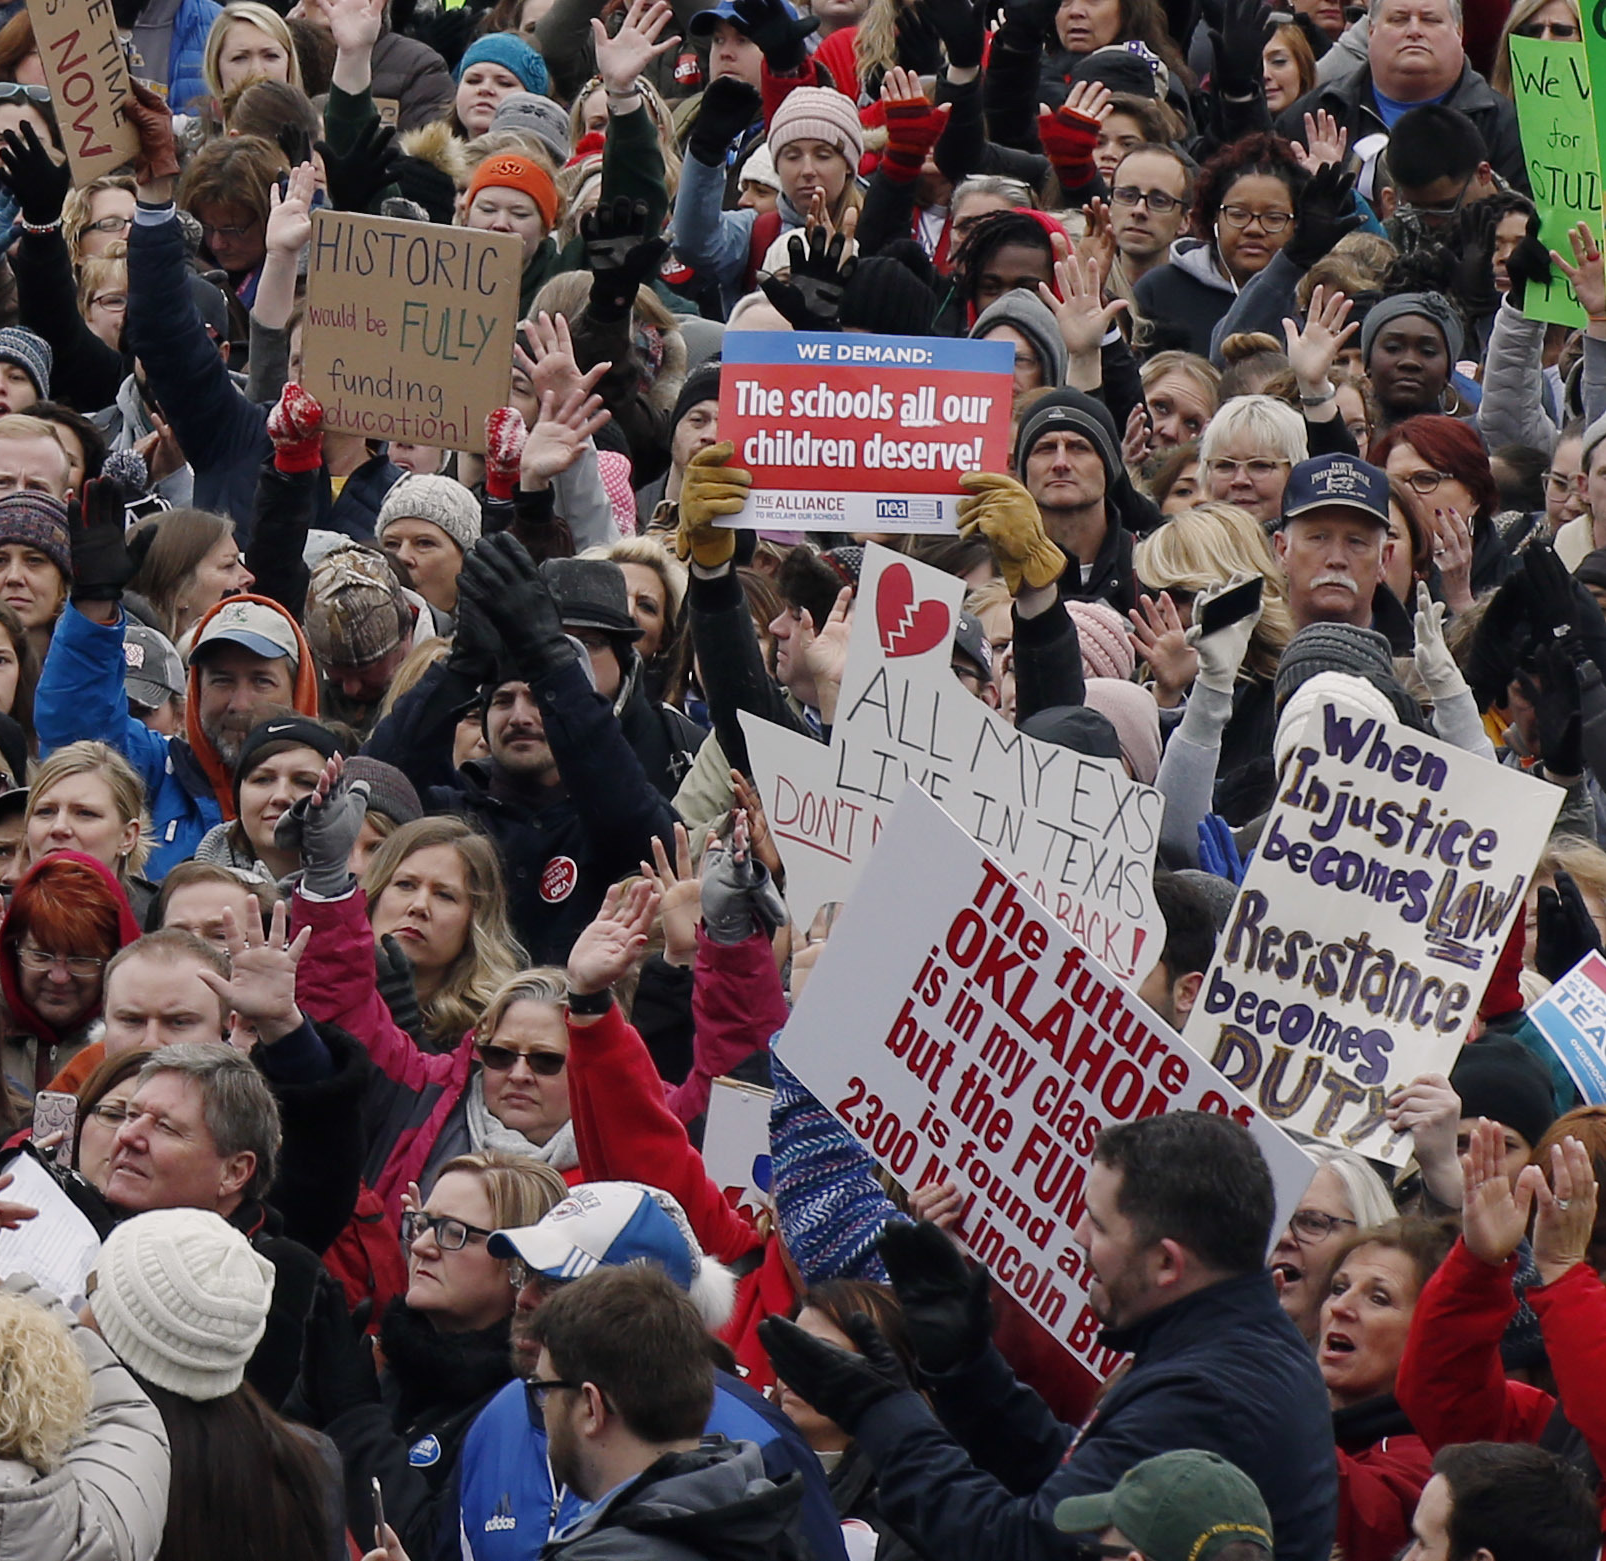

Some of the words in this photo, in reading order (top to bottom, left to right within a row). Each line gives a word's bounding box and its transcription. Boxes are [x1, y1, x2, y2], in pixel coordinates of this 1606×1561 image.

[48, 29, 113, 161] NOW
[95, 25, 131, 130] TIME
[315, 218, 499, 297] HISTORIC
[308, 303, 358, 332] would
[365, 307, 389, 337] be
[399, 300, 497, 366] FULLY
[797, 343, 832, 360] WE
[837, 345, 933, 364] DEMAND:
[327, 359, 444, 417] funding
[735, 380, 784, 417] The
[790, 382, 895, 420] schools
[900, 386, 936, 421] all
[942, 395, 993, 424] our
[319, 397, 470, 442] ducation!
[744, 430, 856, 468] children
[862, 432, 984, 472] deserve!
[756, 495, 774, 505] THE
[775, 496, 846, 511] ALLIANCE
[797, 512, 812, 520] OUR
[813, 512, 846, 521] SCHOOLS
[878, 500, 906, 517] nea
[1322, 703, 1448, 792] When
[1279, 745, 1498, 871] Injustice
[1262, 814, 1433, 924] becomes
[1223, 889, 1471, 1036] Resistance
[1204, 966, 1394, 1085] becomes
[484, 1516, 516, 1532] adidas
